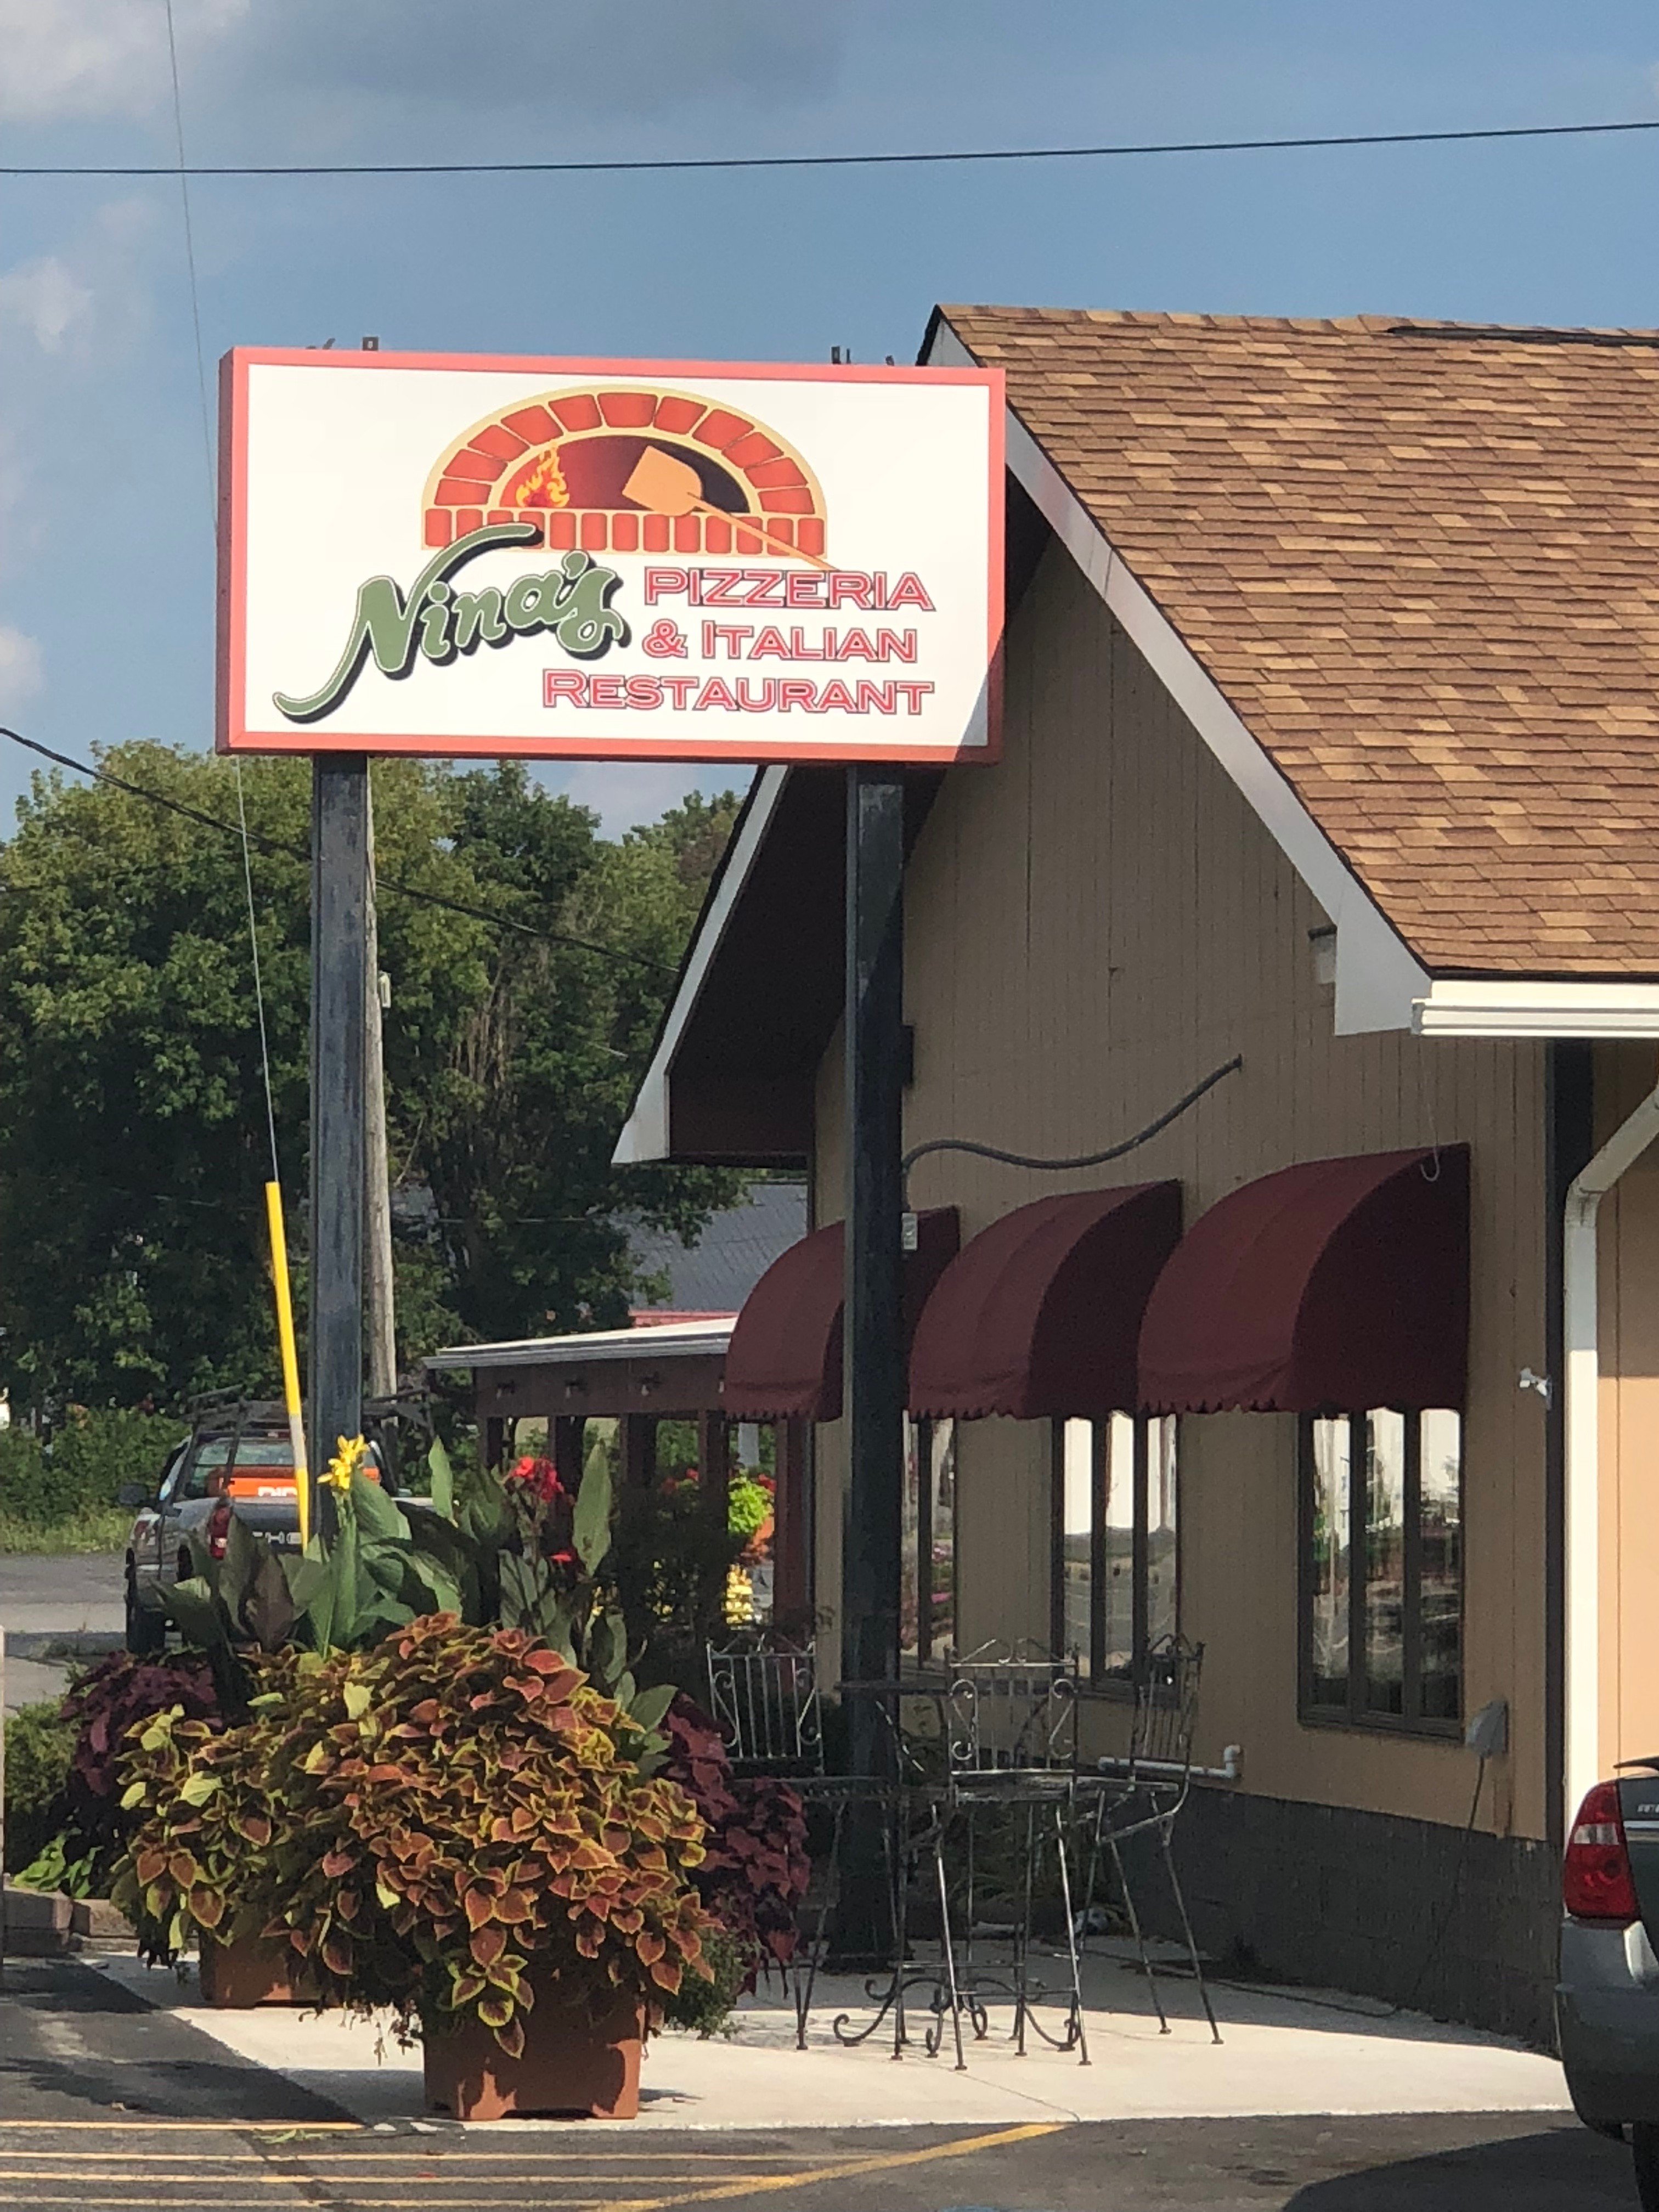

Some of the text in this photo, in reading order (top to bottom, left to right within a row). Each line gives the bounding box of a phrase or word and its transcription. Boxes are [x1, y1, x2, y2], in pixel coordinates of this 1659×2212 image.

[644, 566, 936, 611] PIZZERIA
[273, 523, 631, 724] Nina's
[641, 619, 917, 663] & ITALIAN
[543, 669, 935, 715] RESTAURANT
